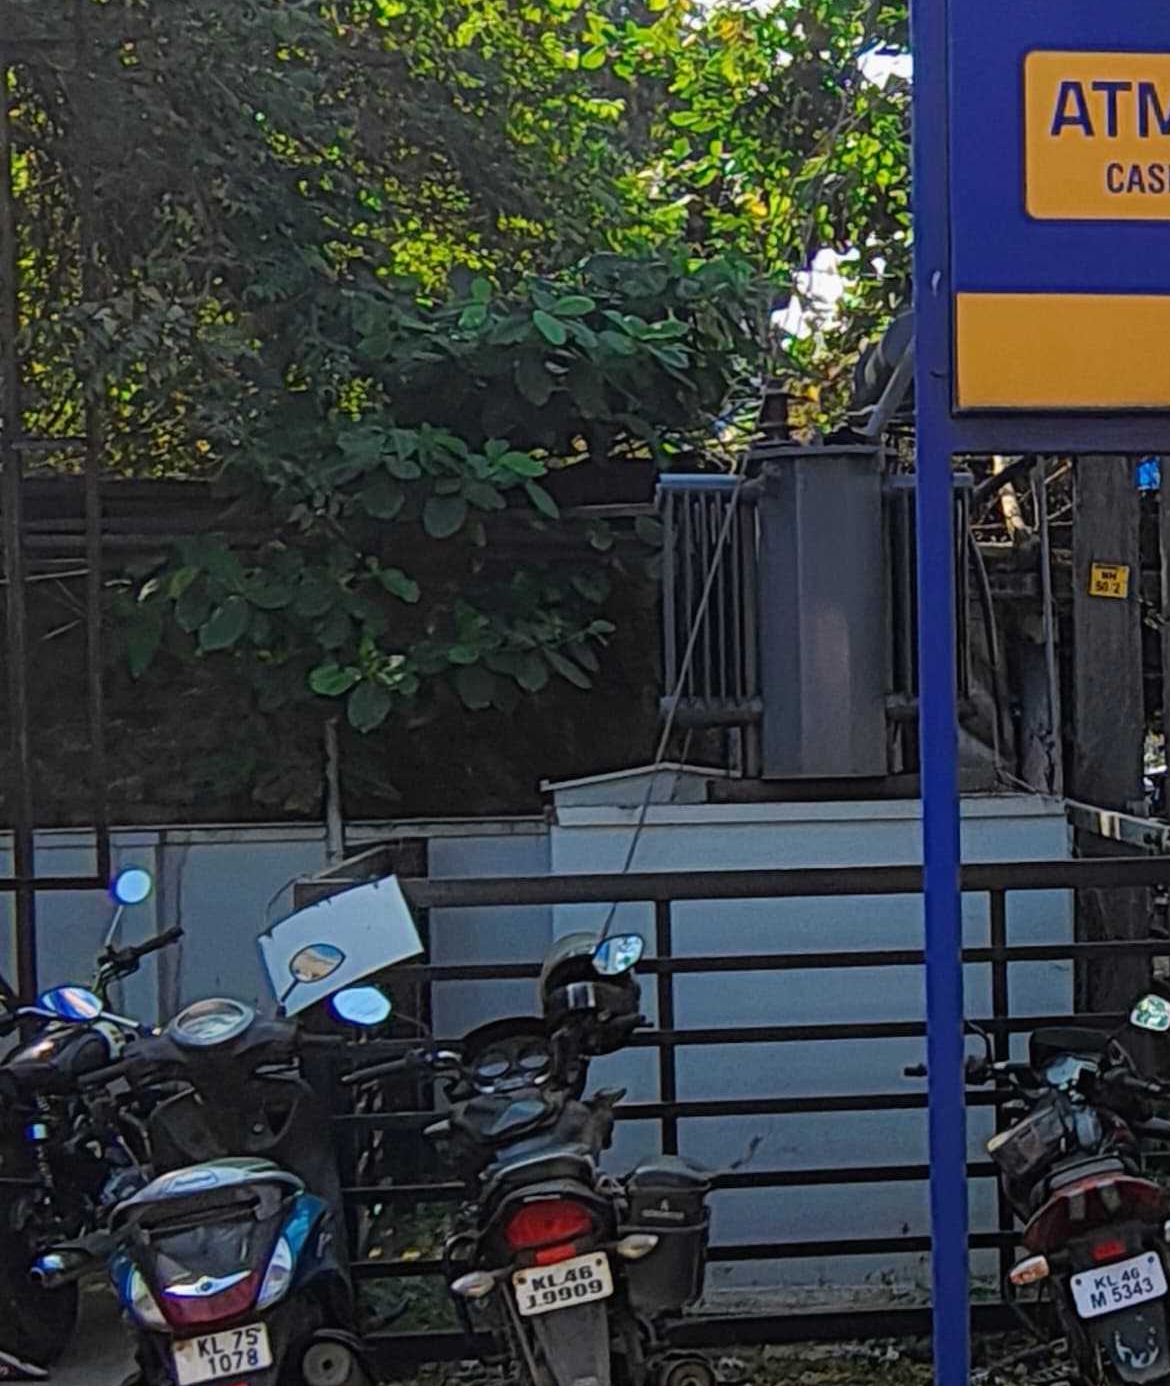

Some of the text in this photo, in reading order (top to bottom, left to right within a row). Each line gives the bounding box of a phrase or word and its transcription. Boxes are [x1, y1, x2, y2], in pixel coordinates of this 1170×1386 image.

[1090, 1277, 1154, 1309] M 5343
[1094, 1274, 1117, 1290] KL
[197, 1327, 261, 1357] KL 75
[208, 1348, 259, 1375] 1078
